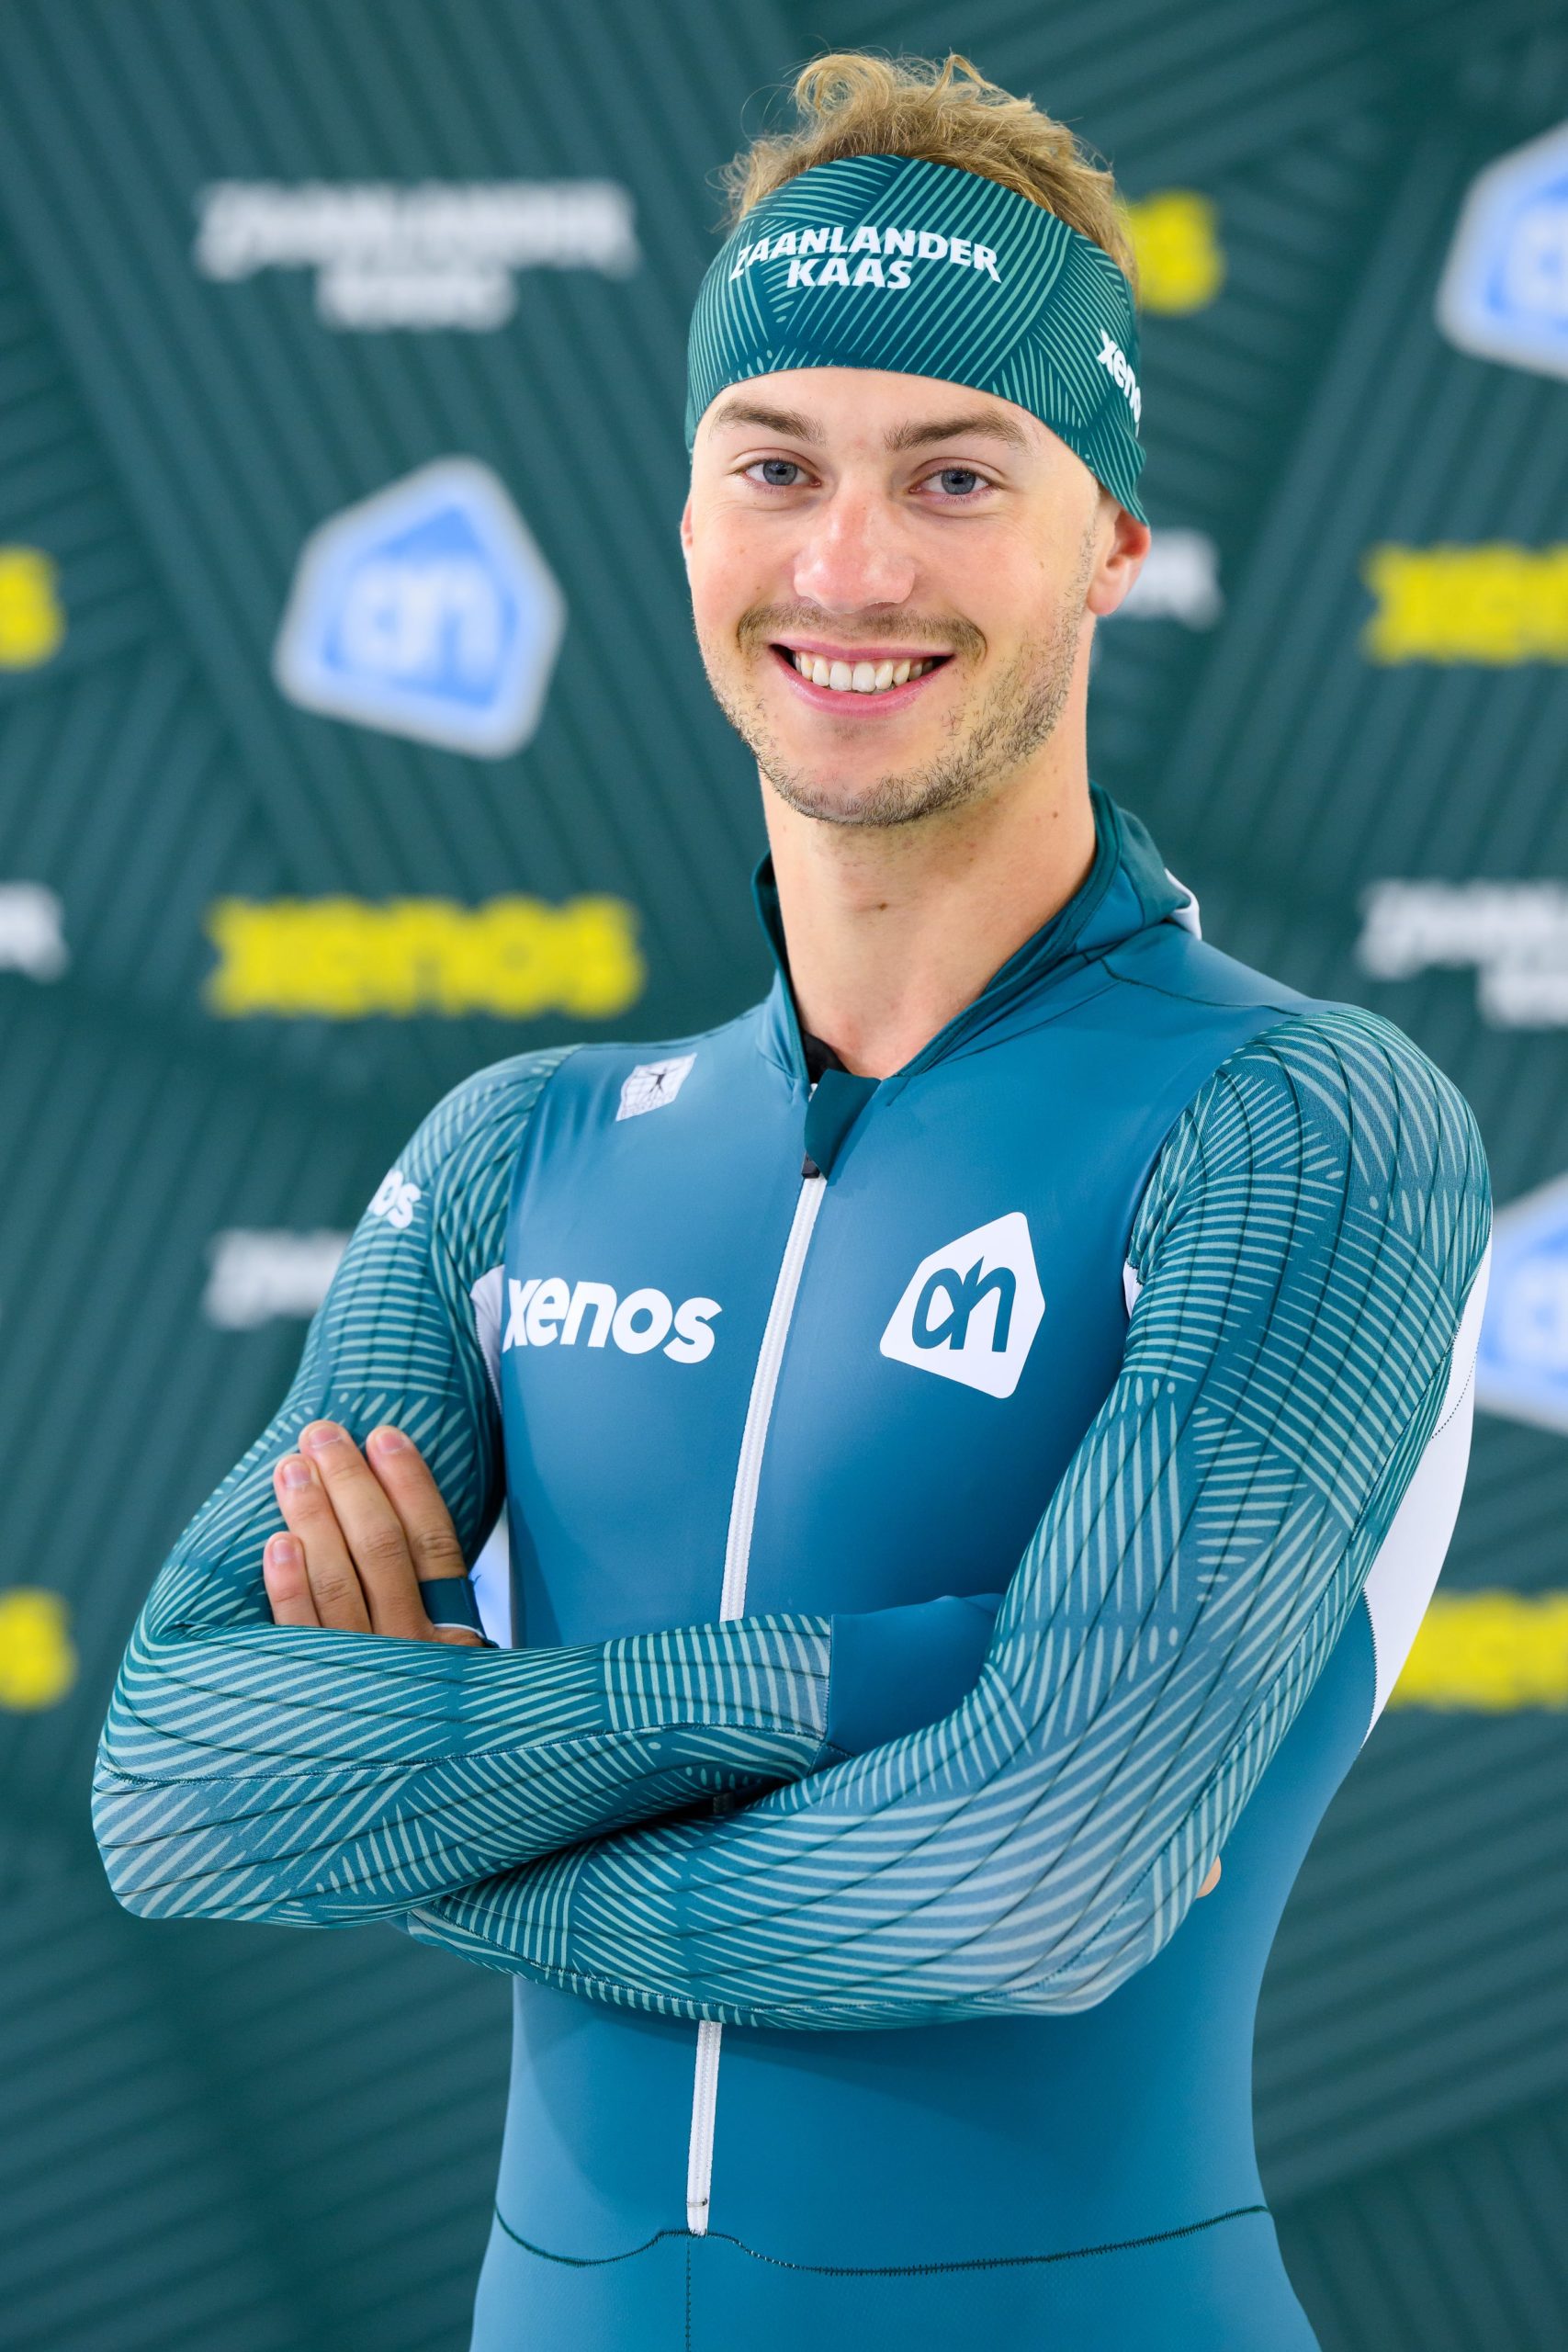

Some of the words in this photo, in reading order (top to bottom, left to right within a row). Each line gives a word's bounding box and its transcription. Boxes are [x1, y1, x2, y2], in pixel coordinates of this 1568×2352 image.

[728, 225, 1002, 284] ZAANLANDER
[786, 257, 913, 289] KAAS
[1097, 328, 1142, 439] xeno
[369, 1169, 423, 1229] os
[502, 1277, 723, 1364] xenos
